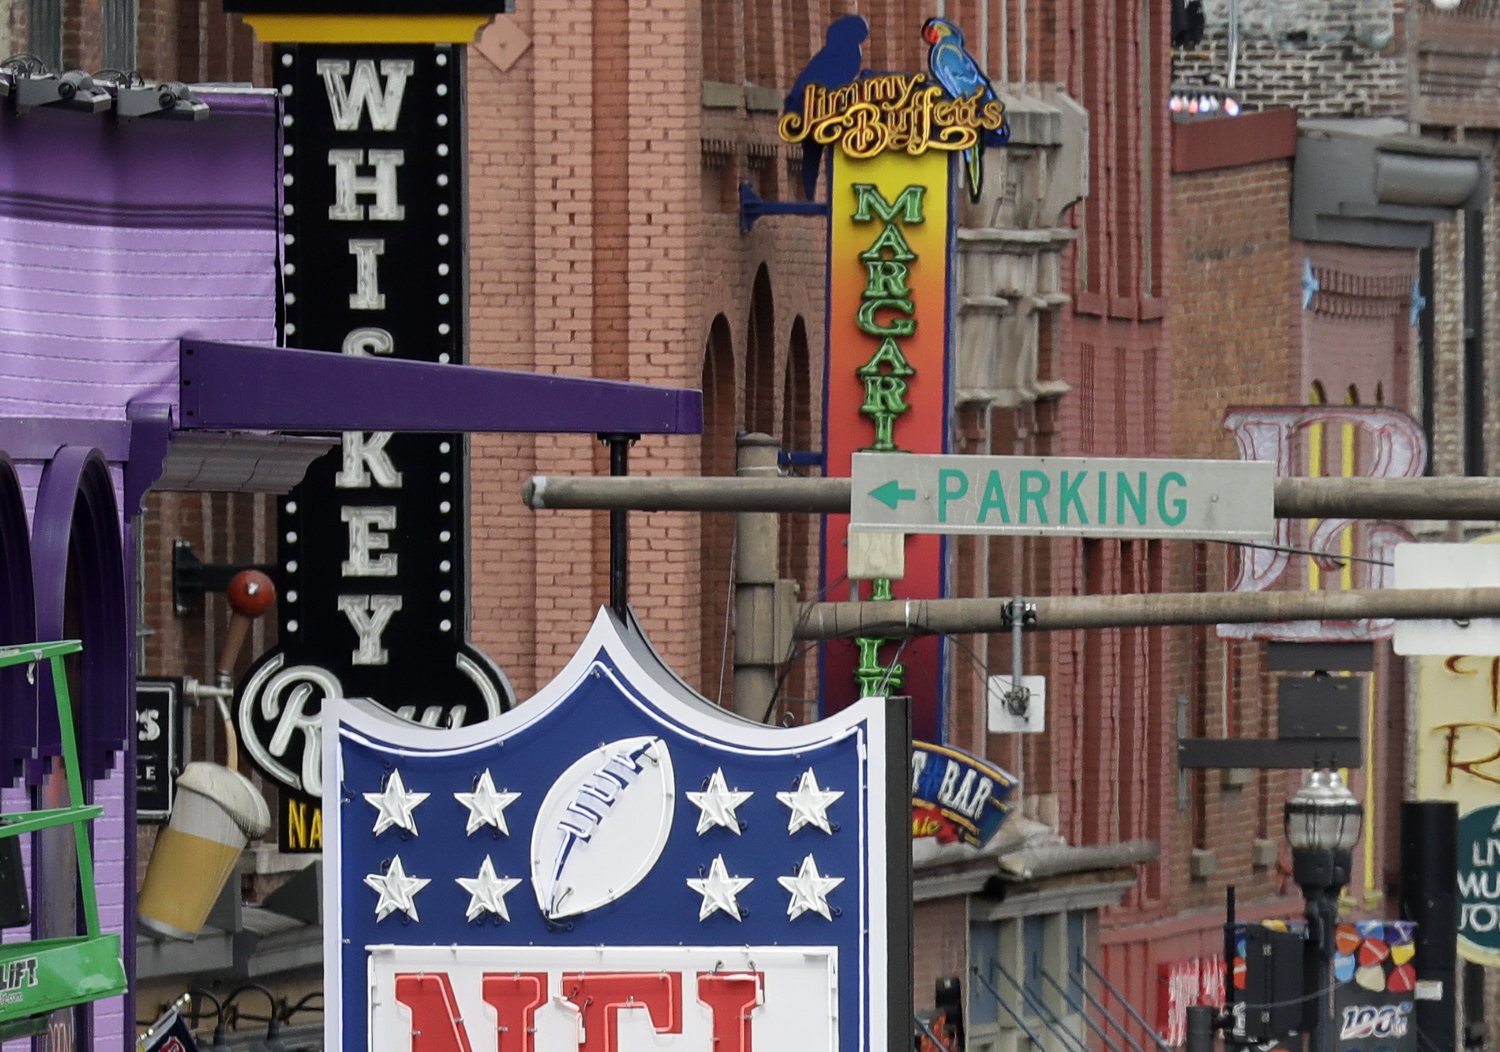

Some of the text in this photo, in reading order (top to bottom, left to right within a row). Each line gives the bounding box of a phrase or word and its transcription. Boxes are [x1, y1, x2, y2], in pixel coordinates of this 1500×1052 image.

[779, 73, 926, 143] Jimmy
[938, 468, 1189, 527] PARKING
[937, 759, 994, 821] BAR
